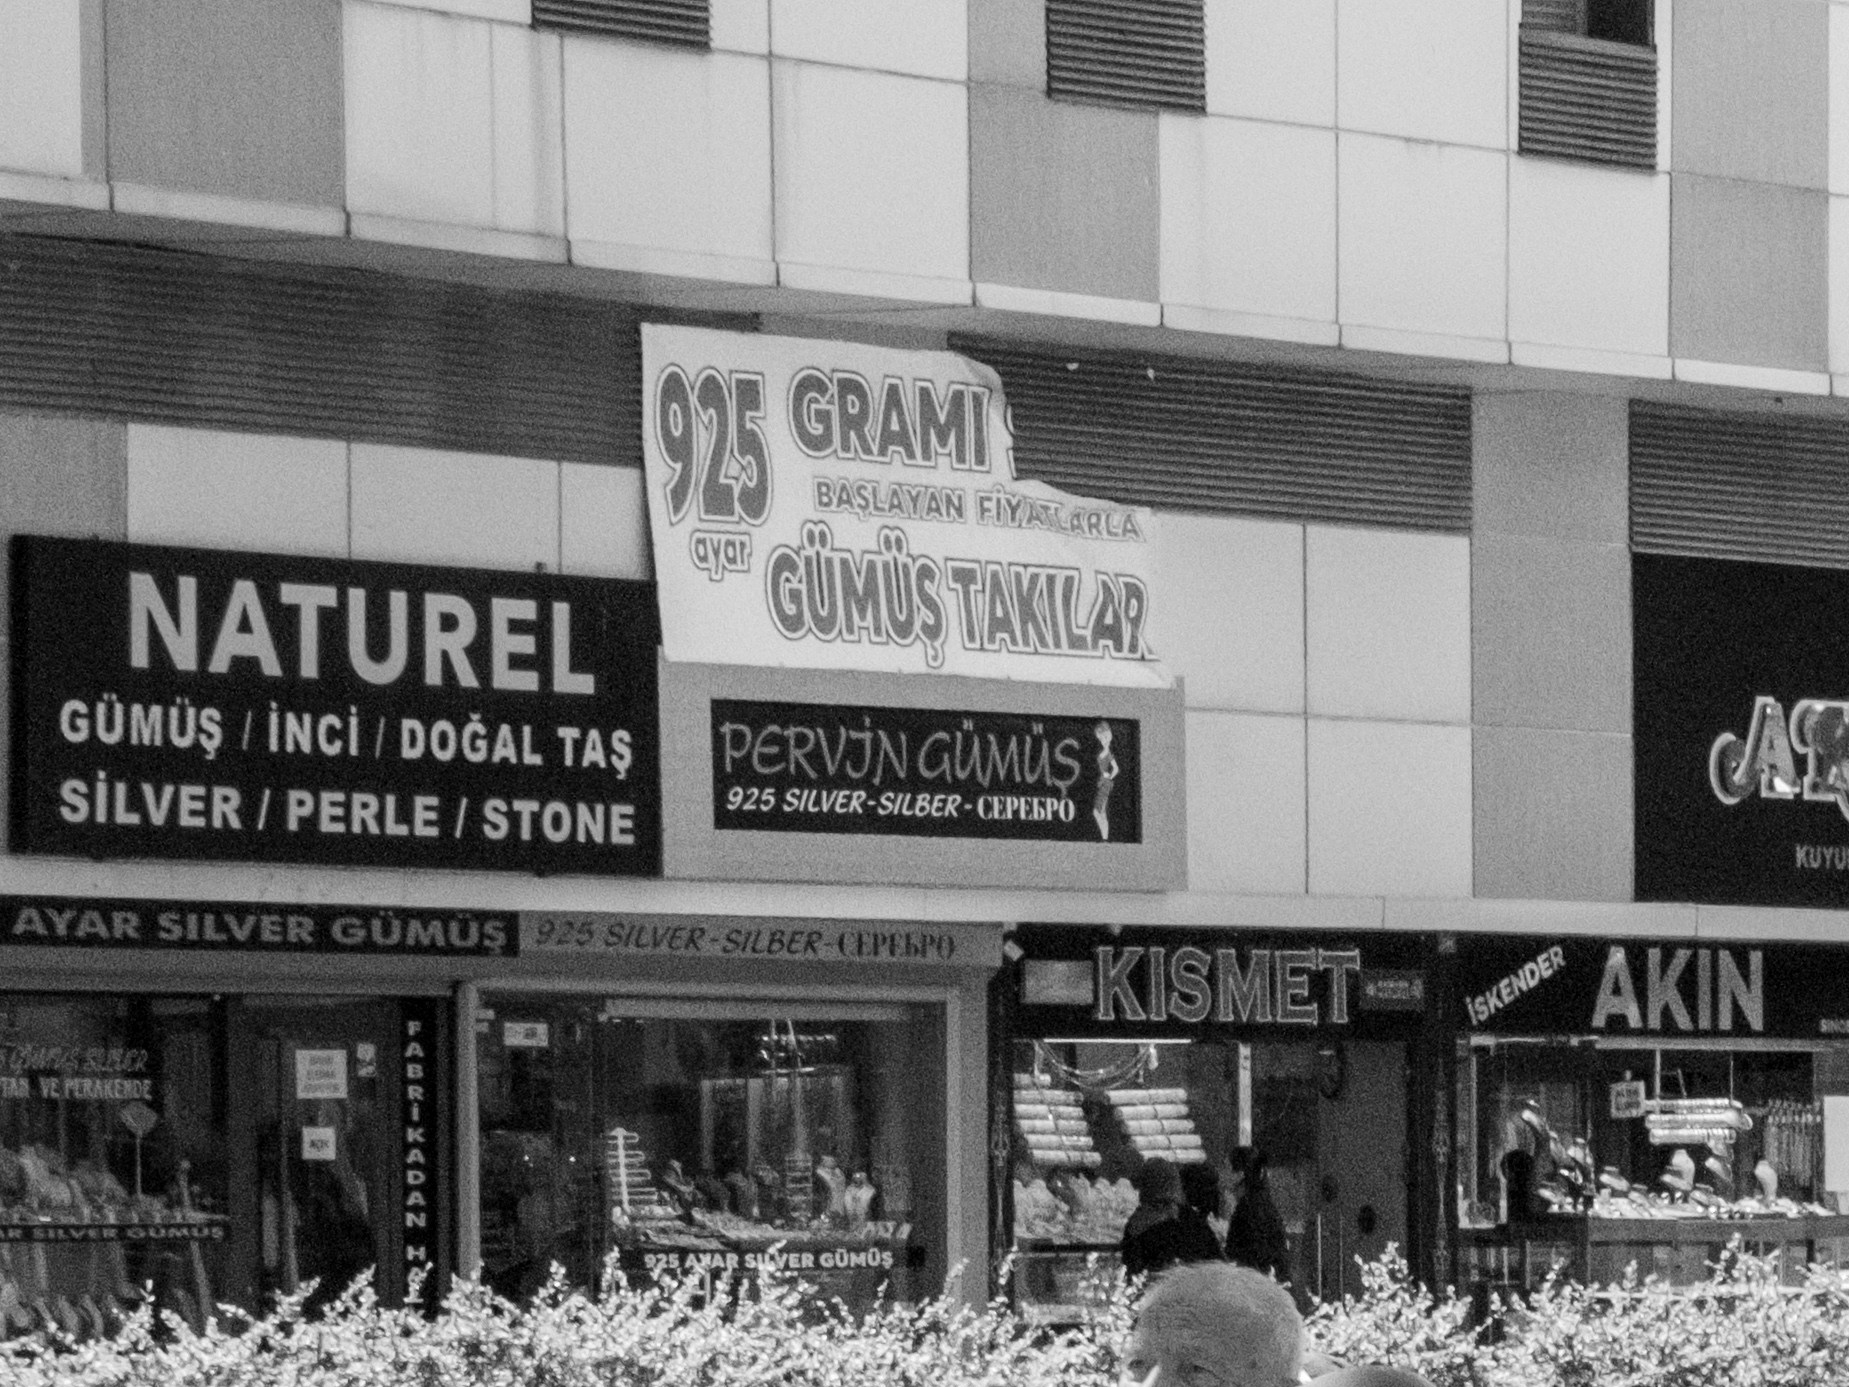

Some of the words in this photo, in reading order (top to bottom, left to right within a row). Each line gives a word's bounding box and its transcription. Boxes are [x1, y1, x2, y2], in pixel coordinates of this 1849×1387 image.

[655, 363, 772, 525] 925
[814, 477, 966, 520] BAŞLAYAN
[690, 530, 750, 580] ayar
[766, 521, 949, 668] GÜMÜŞ
[129, 572, 595, 696] NATUREL
[59, 695, 223, 760] GÜMÜŞ
[268, 703, 360, 757] İNCİ
[400, 710, 543, 768] DOĞAL
[556, 726, 634, 780] TAŞ
[917, 717, 1083, 800] GÜMÜŞ
[59, 769, 243, 831] SİLVER
[286, 791, 440, 839] PERLE
[483, 798, 636, 846] STONE
[726, 786, 776, 812] 925
[12, 908, 140, 940] AYAR
[157, 911, 314, 944] SILVER
[331, 911, 508, 953] GÜMÜŞ
[535, 920, 595, 946] 925
[1096, 945, 1361, 1026] KISMET
[1466, 944, 1565, 1025] İSKENDER
[1591, 948, 1764, 1031] AKIN
[404, 1020, 426, 1228] FABRİKADAN
[819, 1248, 894, 1270] GÜMÜŞ
